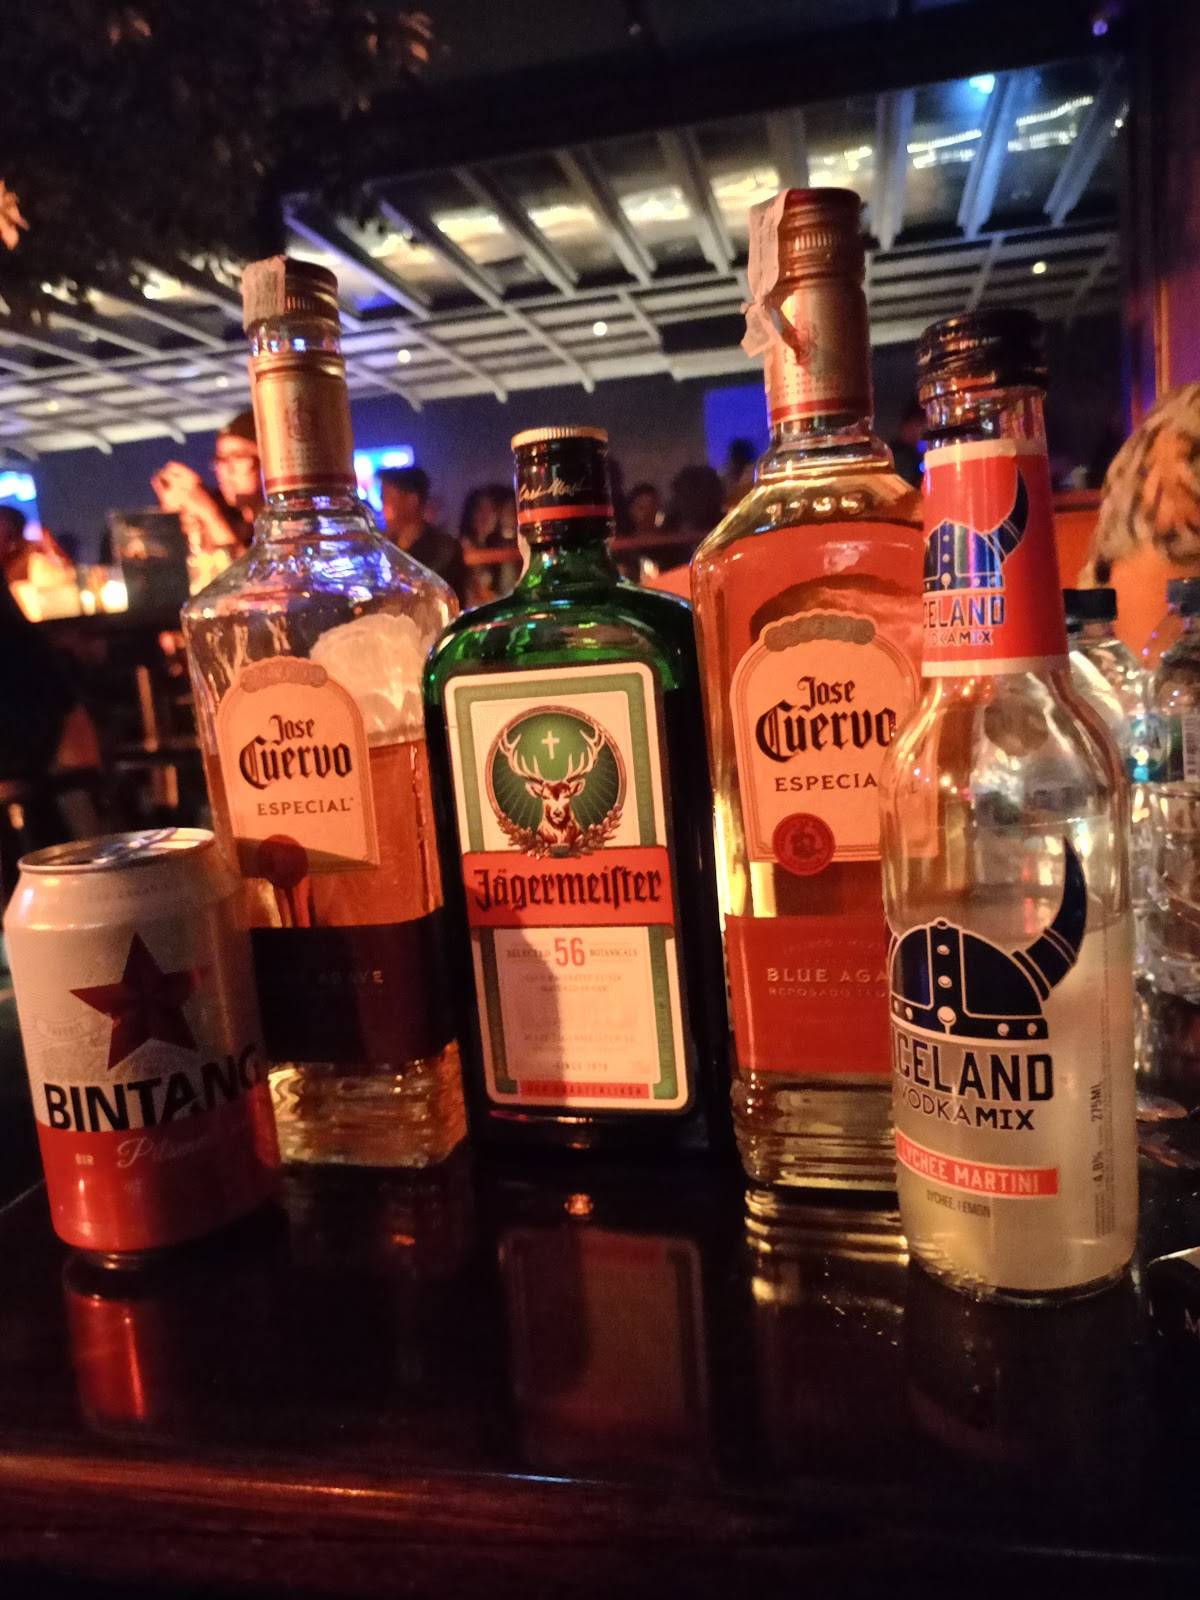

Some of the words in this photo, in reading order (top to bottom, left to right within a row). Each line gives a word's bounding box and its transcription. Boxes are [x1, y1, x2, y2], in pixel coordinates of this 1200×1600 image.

[923, 596, 1005, 628] CELAND
[797, 676, 856, 712] Jose
[269, 714, 315, 745] Jose
[755, 700, 896, 763] Cuervo
[239, 735, 352, 790] Cuervo
[774, 772, 878, 792] ESPECIA
[257, 798, 351, 816] ESPECIAL
[555, 937, 585, 967] 56
[767, 968, 828, 982] BLUE
[839, 969, 888, 982] AGA
[975, 1107, 1036, 1131] MIX
[954, 1164, 1039, 1193] MARTINI
